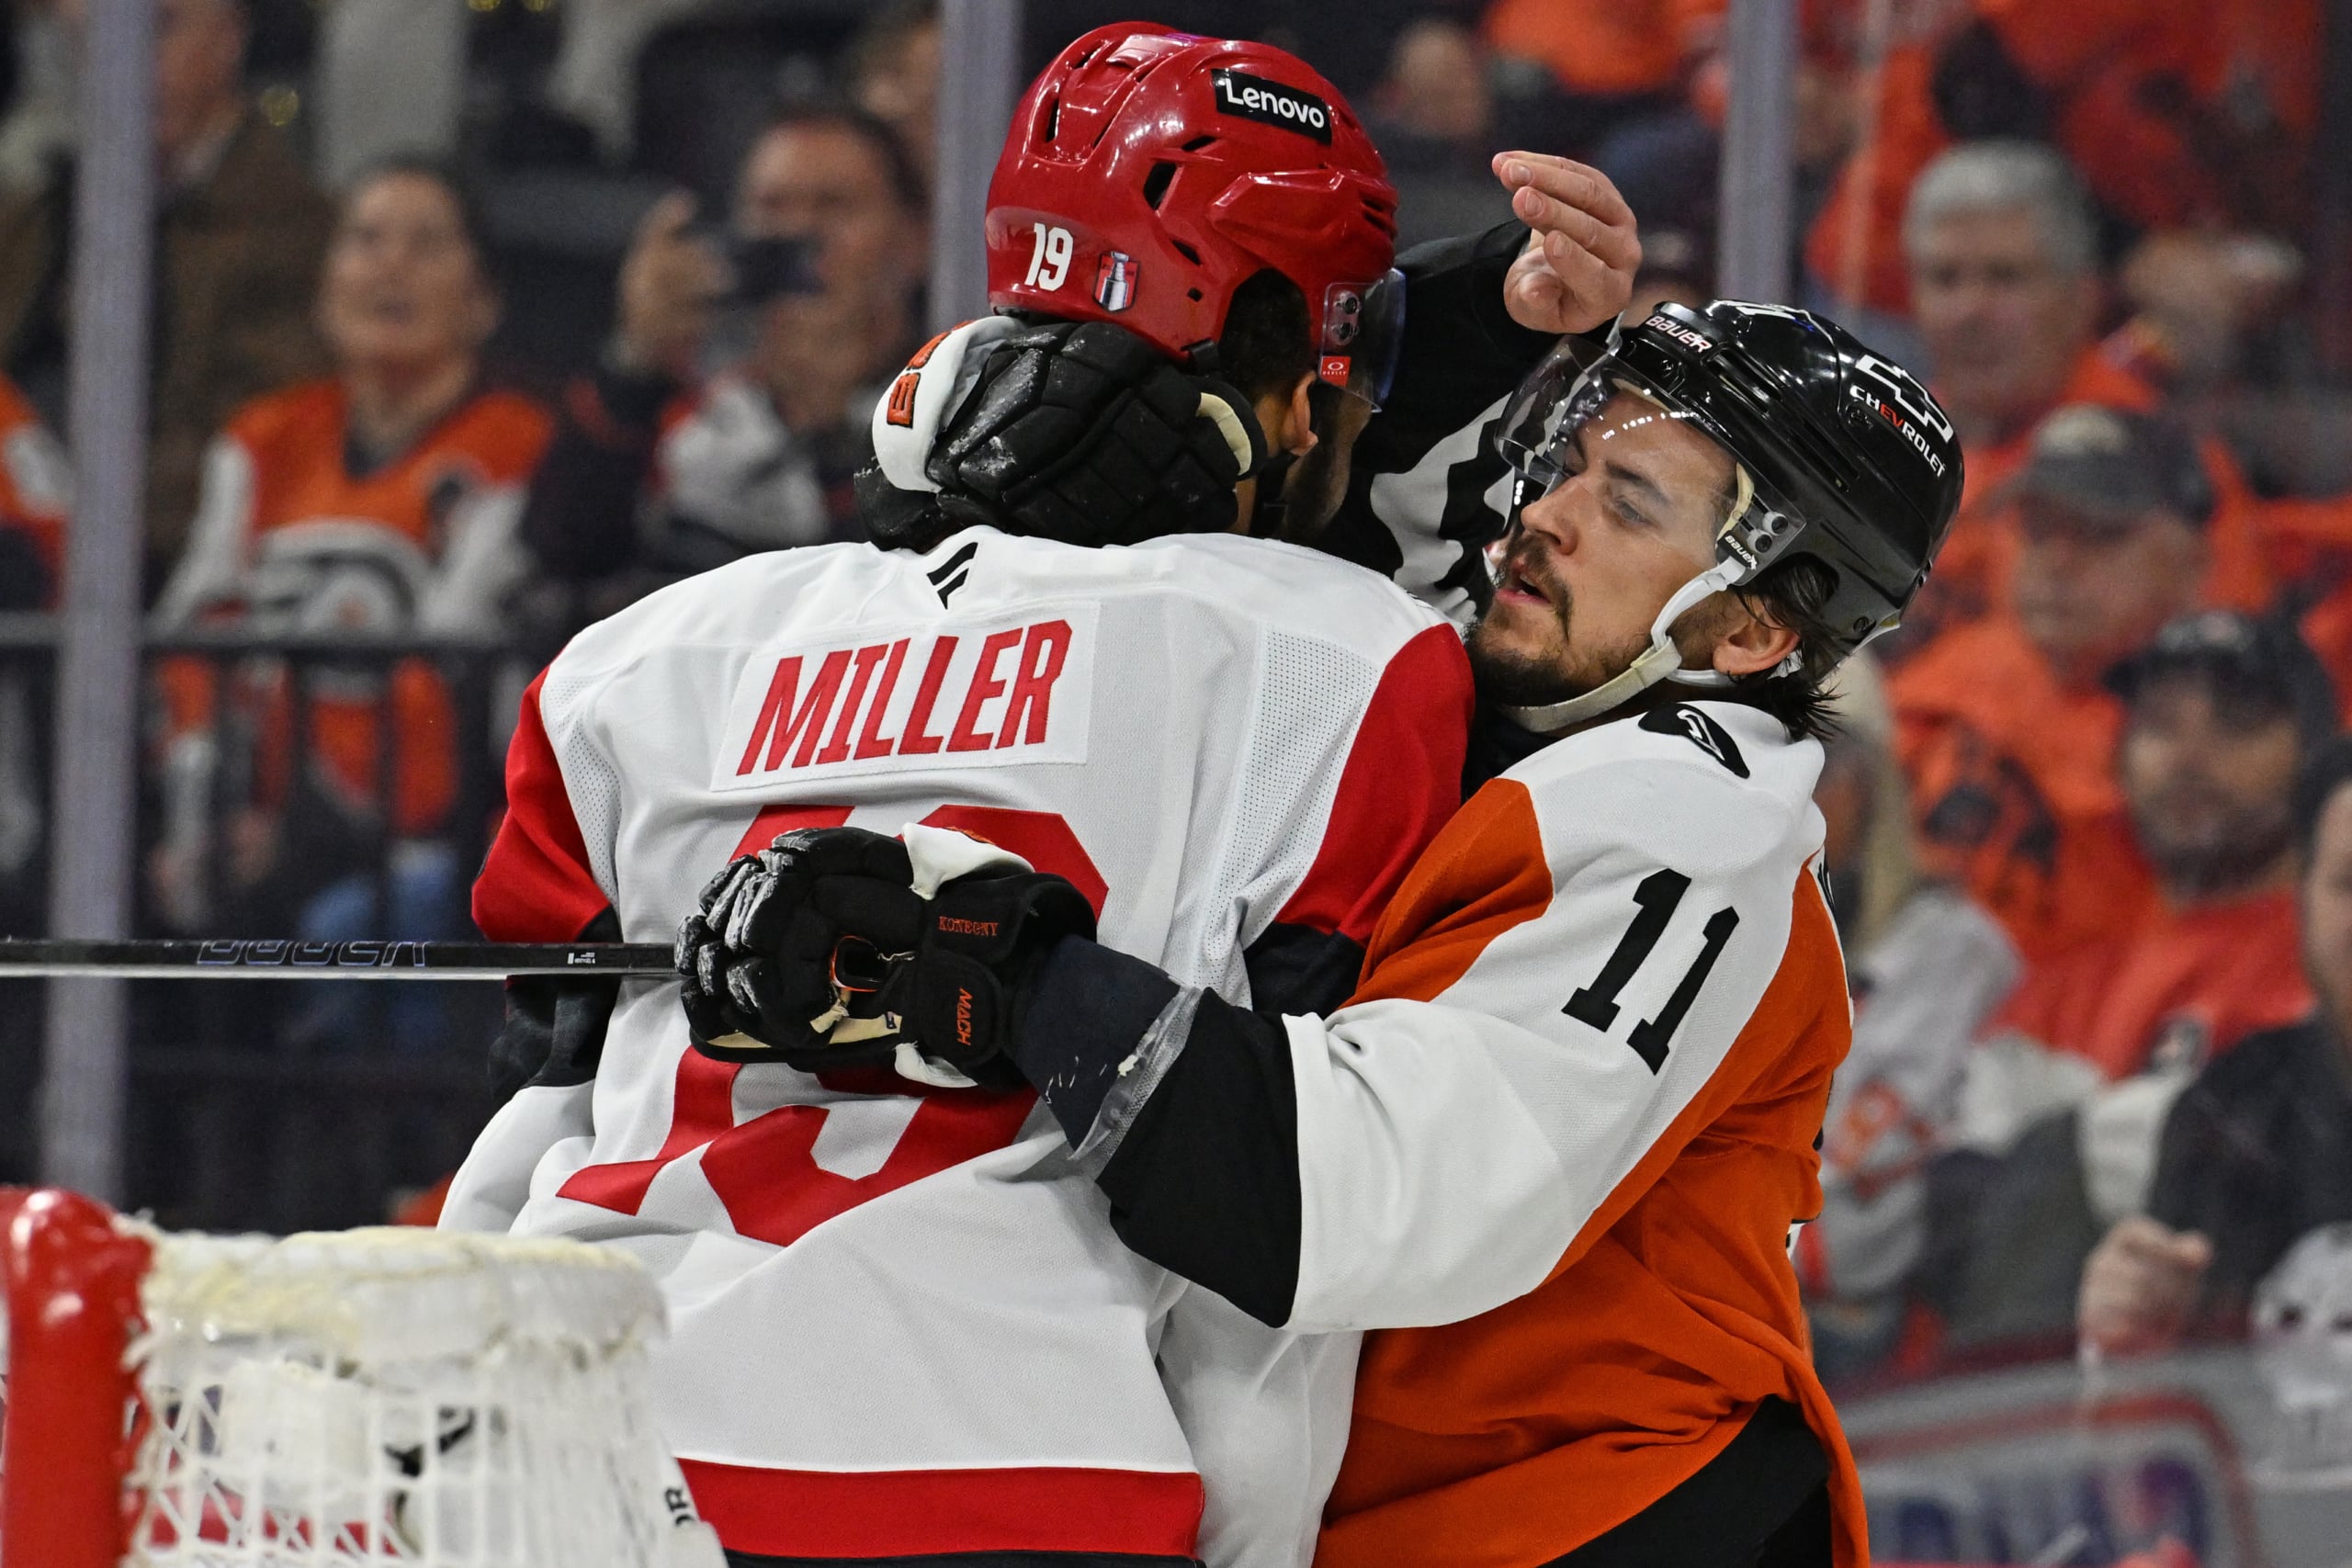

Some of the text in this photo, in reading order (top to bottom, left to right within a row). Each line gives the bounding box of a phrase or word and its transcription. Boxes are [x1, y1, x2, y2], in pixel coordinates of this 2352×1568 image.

[1224, 78, 1325, 129] Lenovo
[1024, 222, 1074, 291] 19
[1849, 385, 1946, 478] CHEVROLET
[735, 619, 1073, 776] MILLER
[938, 916, 1000, 937] KONECNY
[1561, 867, 1740, 1076] 11
[956, 987, 974, 1046] MACH
